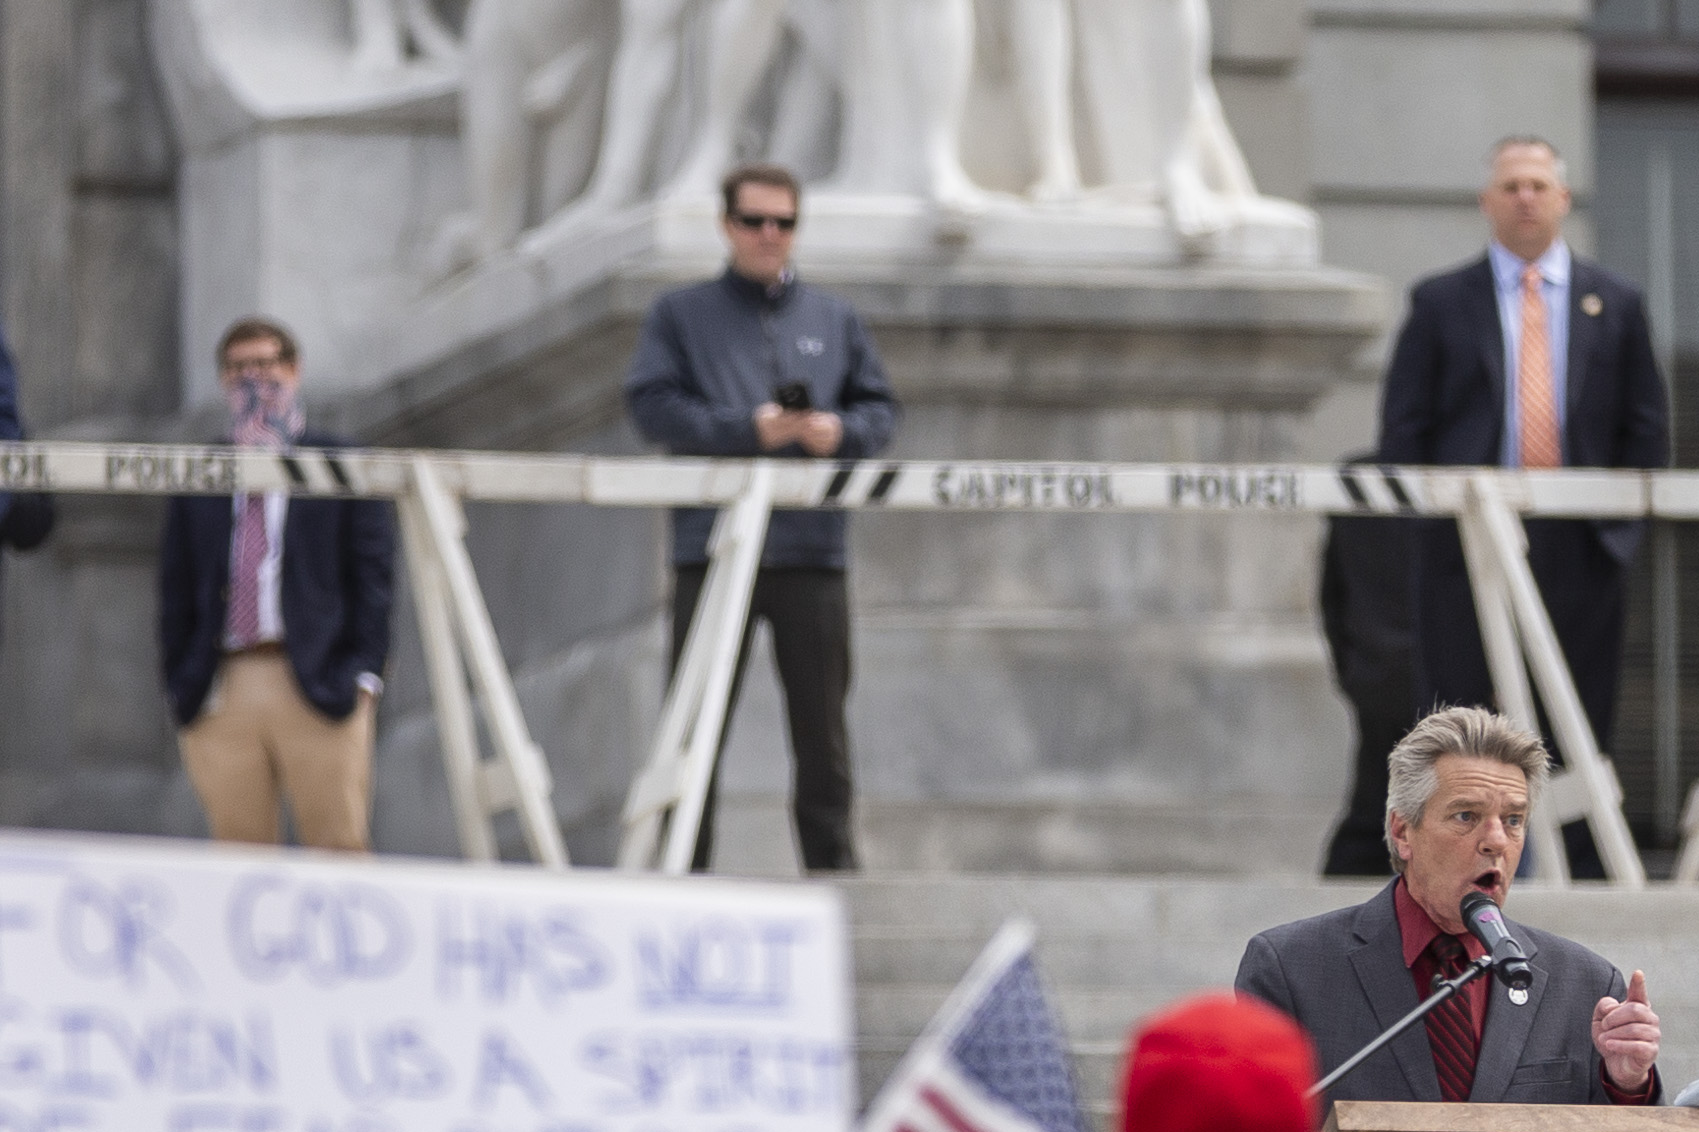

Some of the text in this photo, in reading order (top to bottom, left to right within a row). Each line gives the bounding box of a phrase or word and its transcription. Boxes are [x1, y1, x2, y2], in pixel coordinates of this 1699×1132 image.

[105, 451, 238, 492] POLICE
[931, 463, 1300, 511] CAPITOL POLICE
[224, 872, 414, 992] GOD
[434, 898, 613, 1010] HAS
[636, 916, 808, 1008] NOT
[327, 1022, 453, 1106] US
[472, 1026, 555, 1110] A
[577, 1030, 845, 1113] SPIRIT
